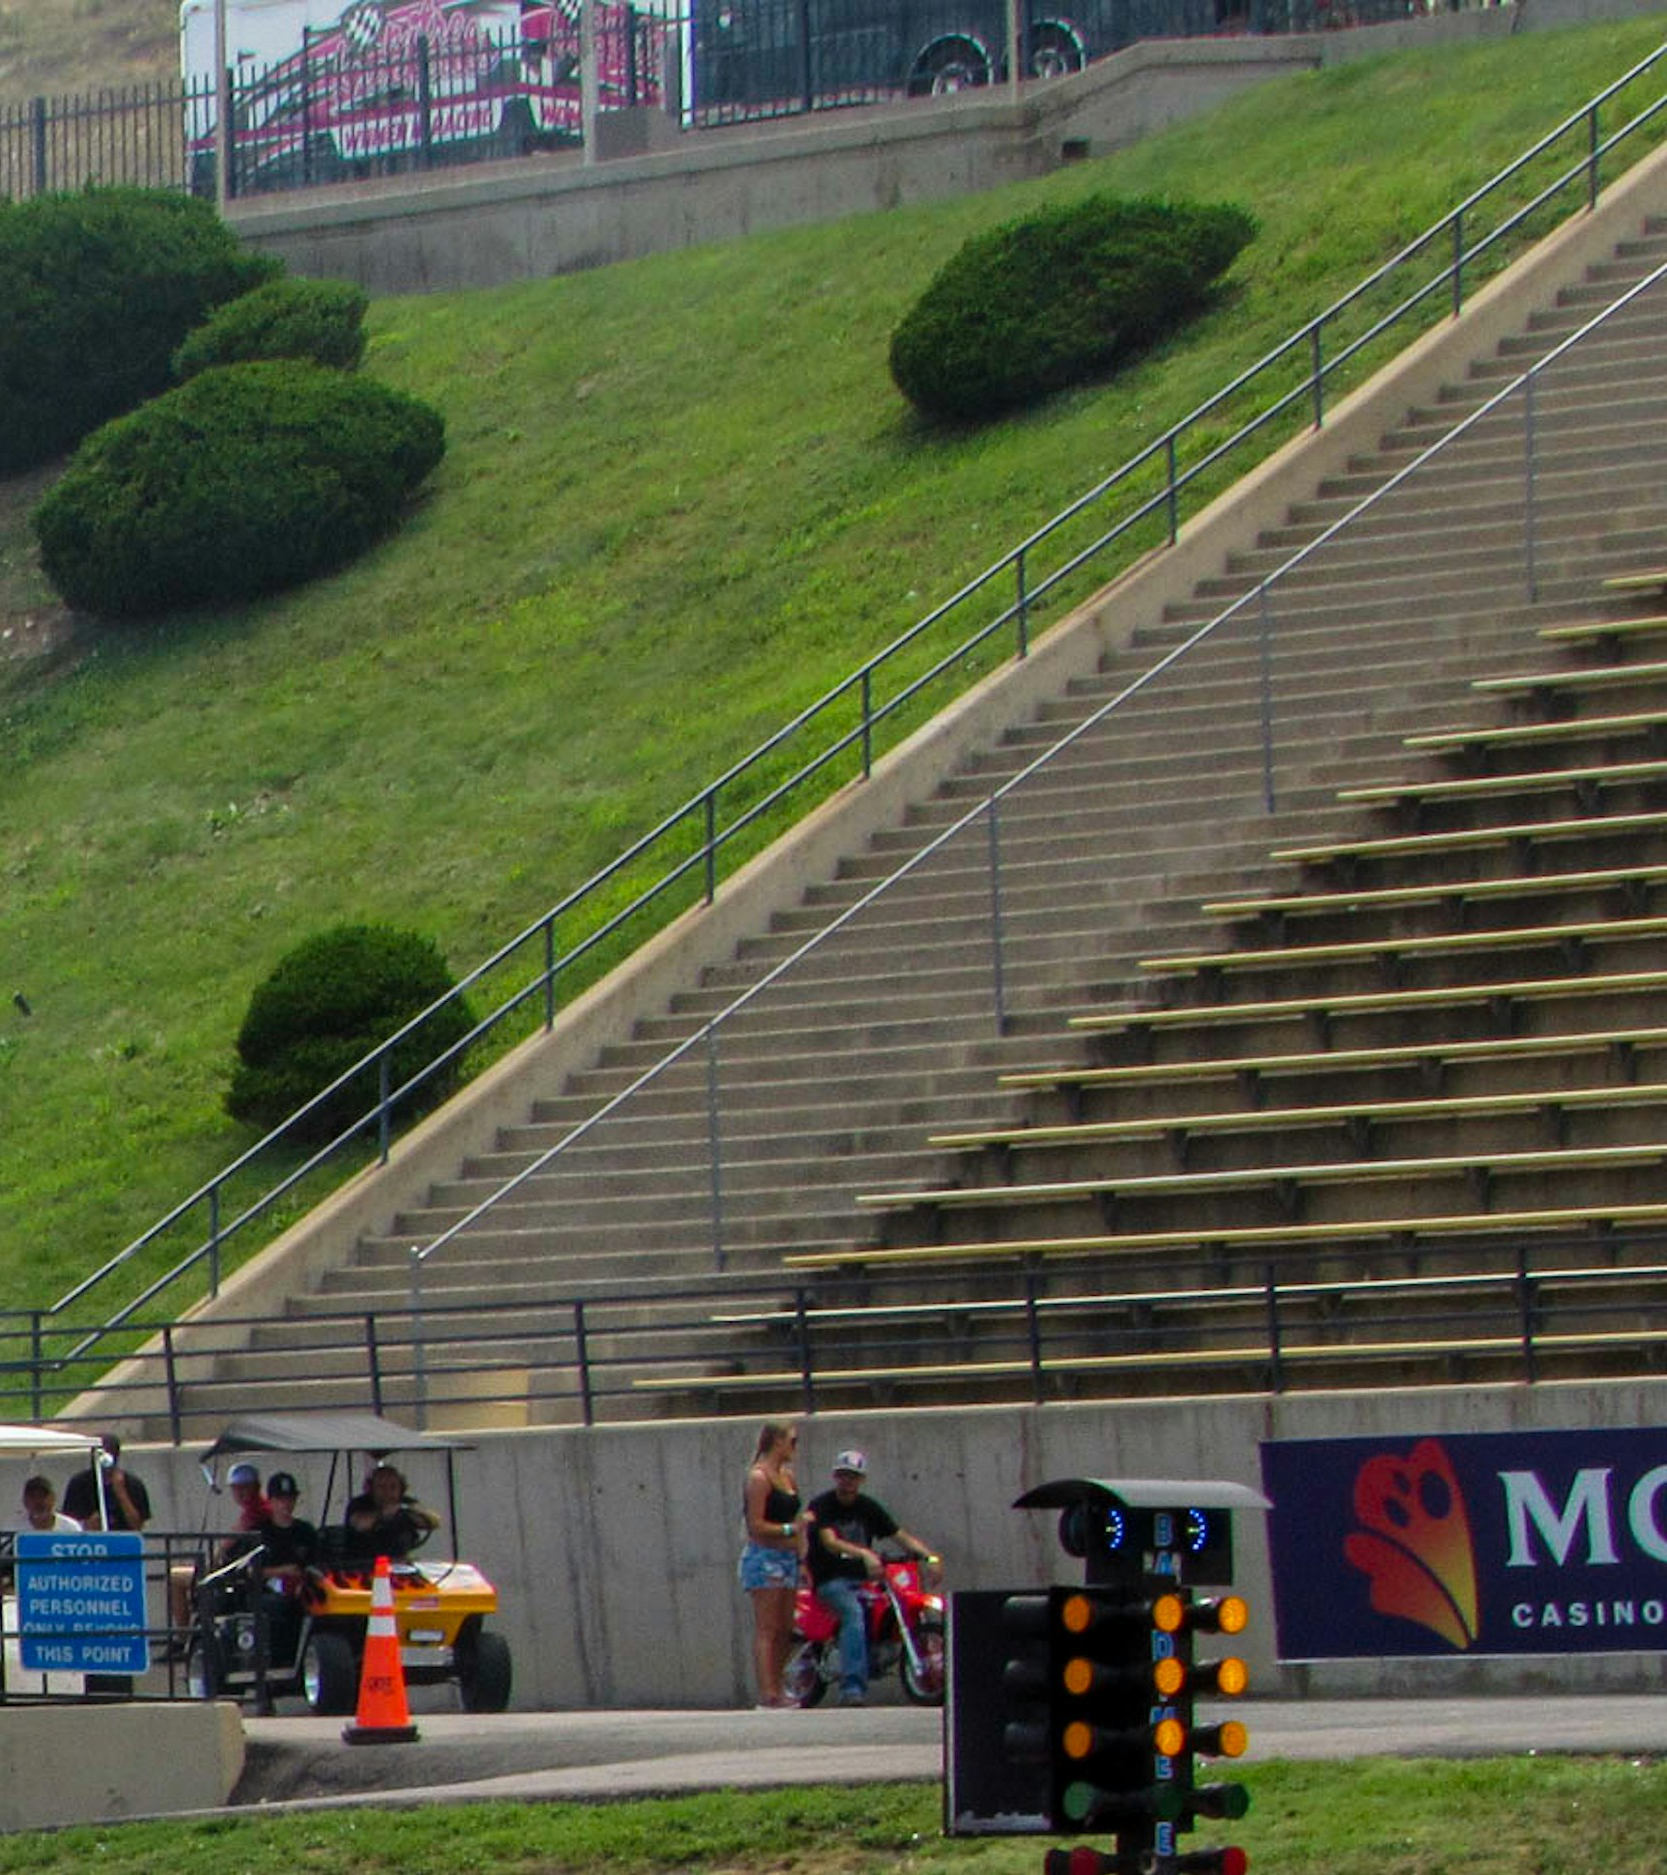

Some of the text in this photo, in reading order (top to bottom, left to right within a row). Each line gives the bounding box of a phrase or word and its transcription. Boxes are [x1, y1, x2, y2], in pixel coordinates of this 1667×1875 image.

[51, 1543, 108, 1565] STOP
[27, 1574, 134, 1593] AUTHORIZED
[29, 1597, 133, 1617] PERSONNEL
[1512, 1600, 1665, 1628] CASINO
[34, 1645, 133, 1664] THIS POINT
